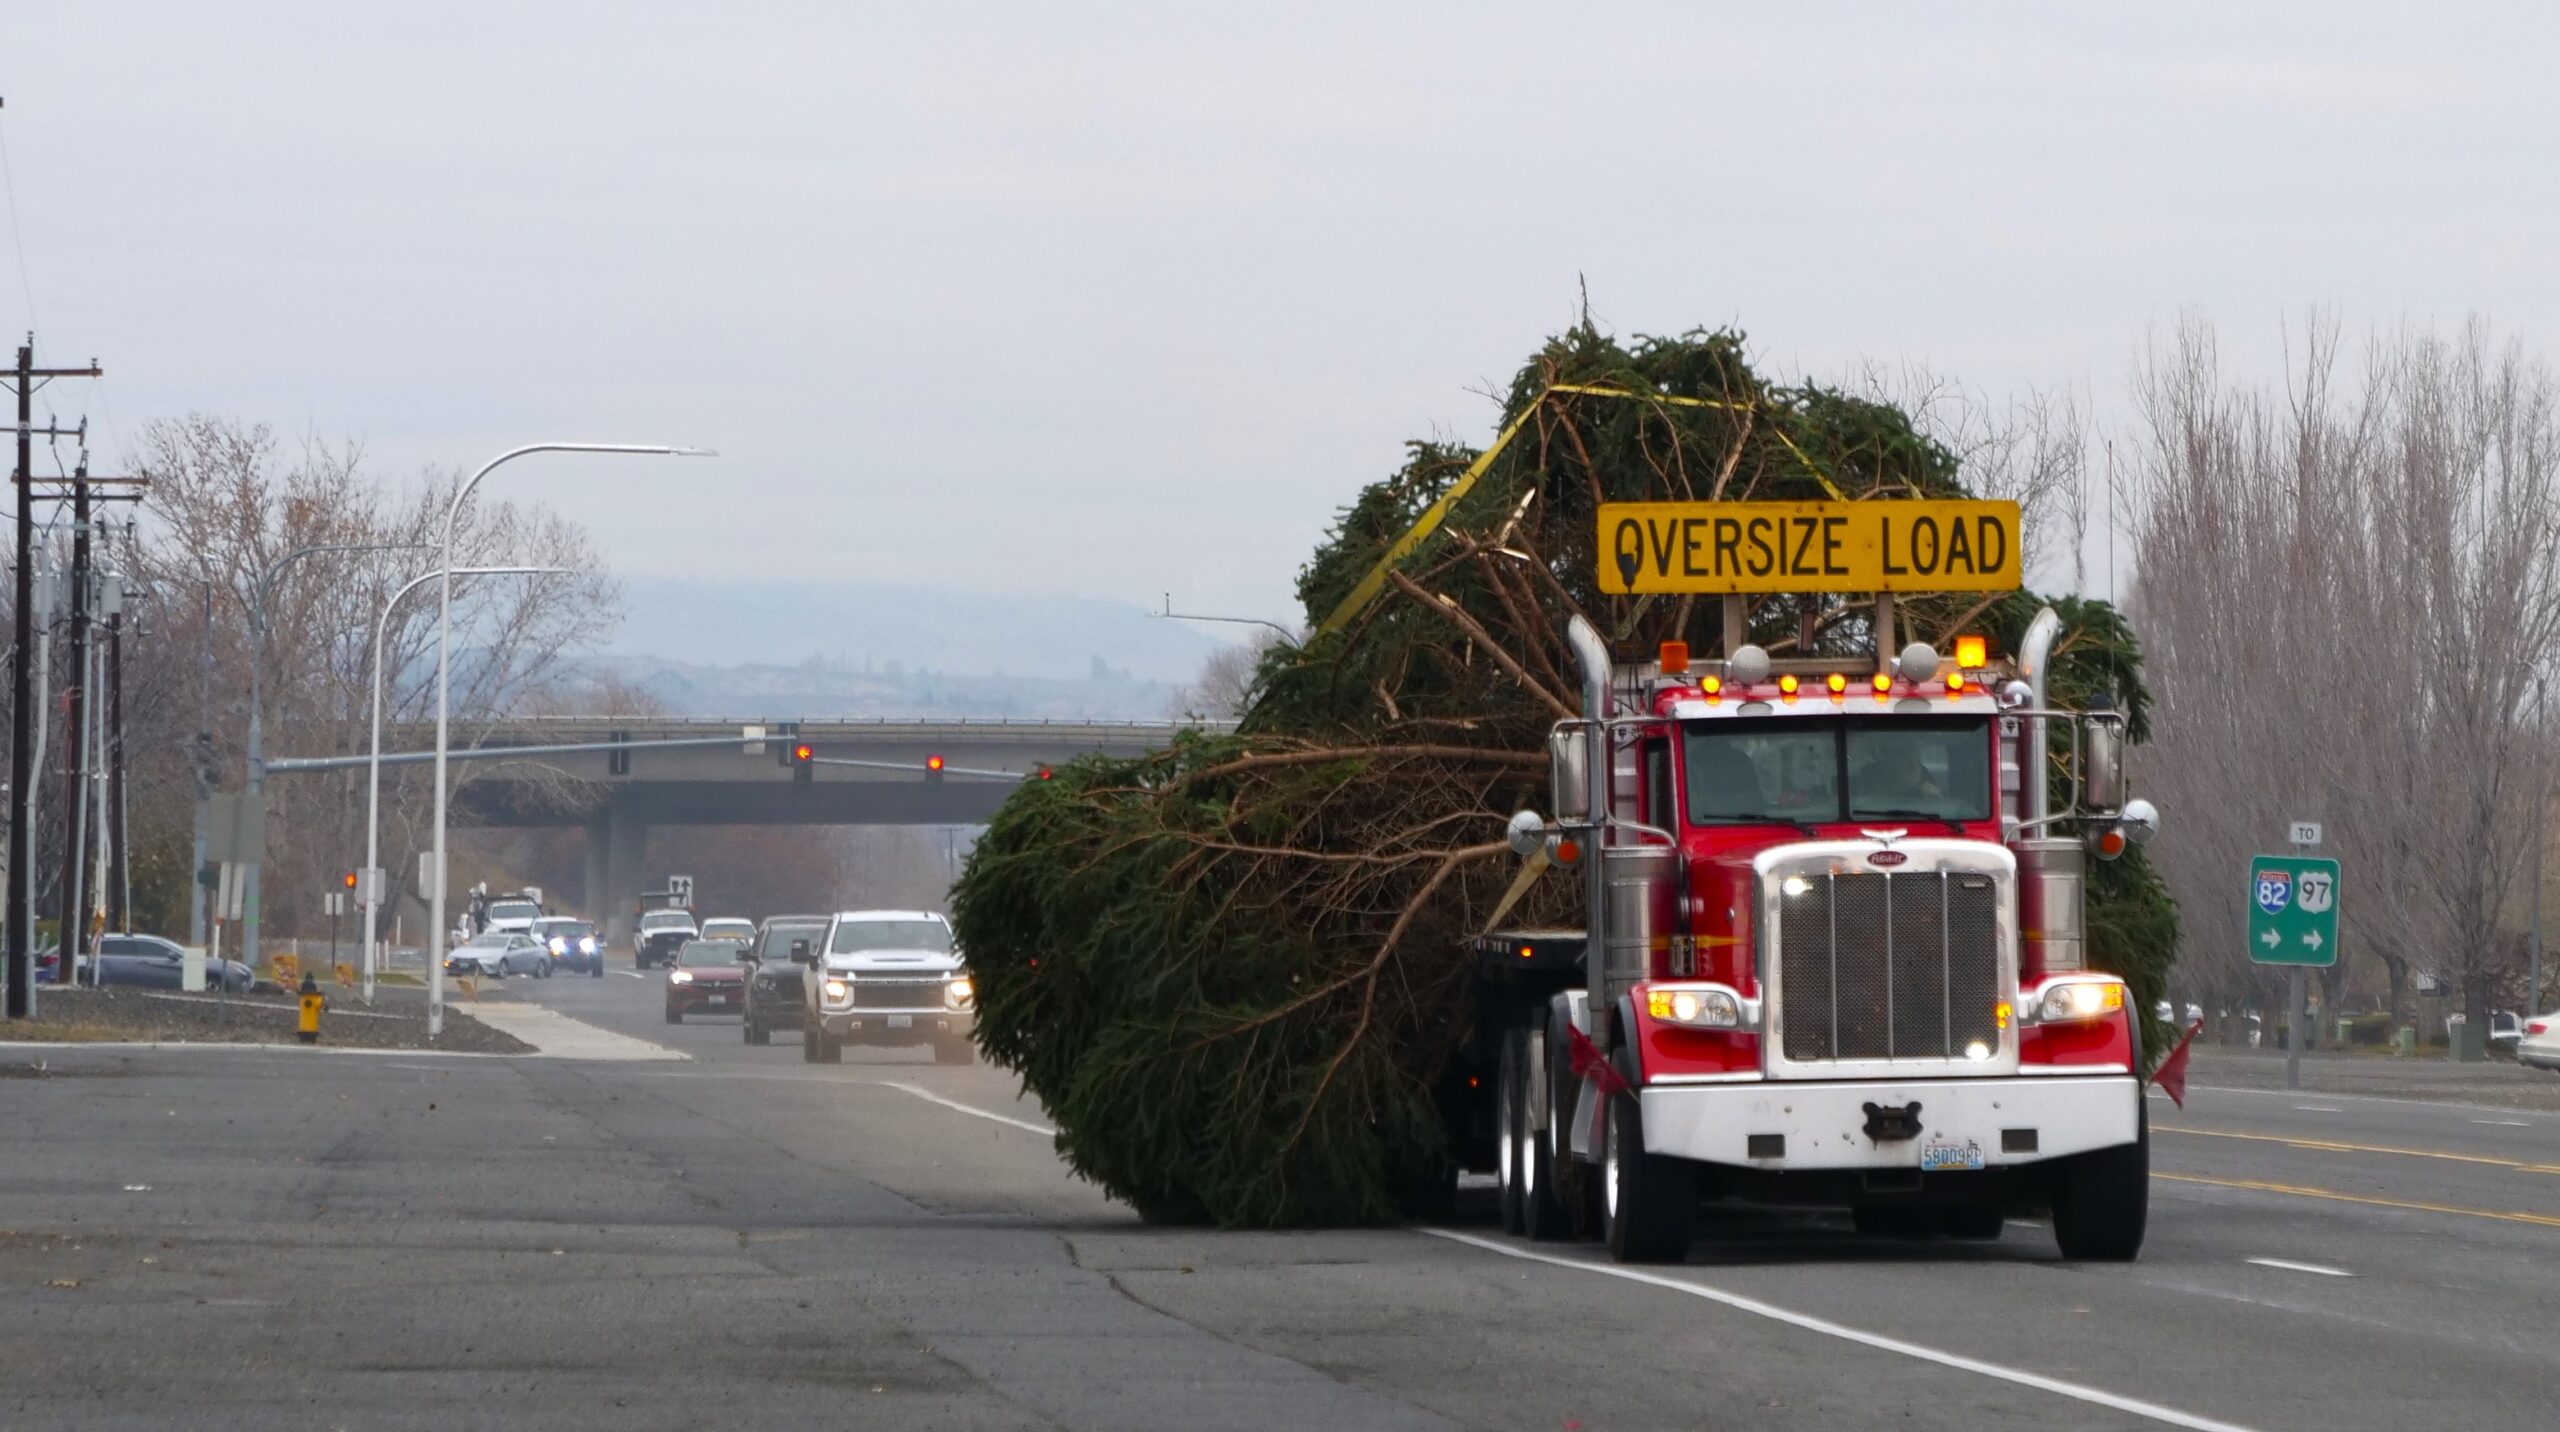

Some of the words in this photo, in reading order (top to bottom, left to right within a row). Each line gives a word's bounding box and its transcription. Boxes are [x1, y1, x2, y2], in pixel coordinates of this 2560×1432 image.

[1615, 517, 1849, 578] OVERSIZE
[1881, 515, 2007, 576] LOAD
[2298, 828, 2314, 841] TO
[2260, 882, 2286, 906] 82
[2302, 881, 2329, 905] 97
